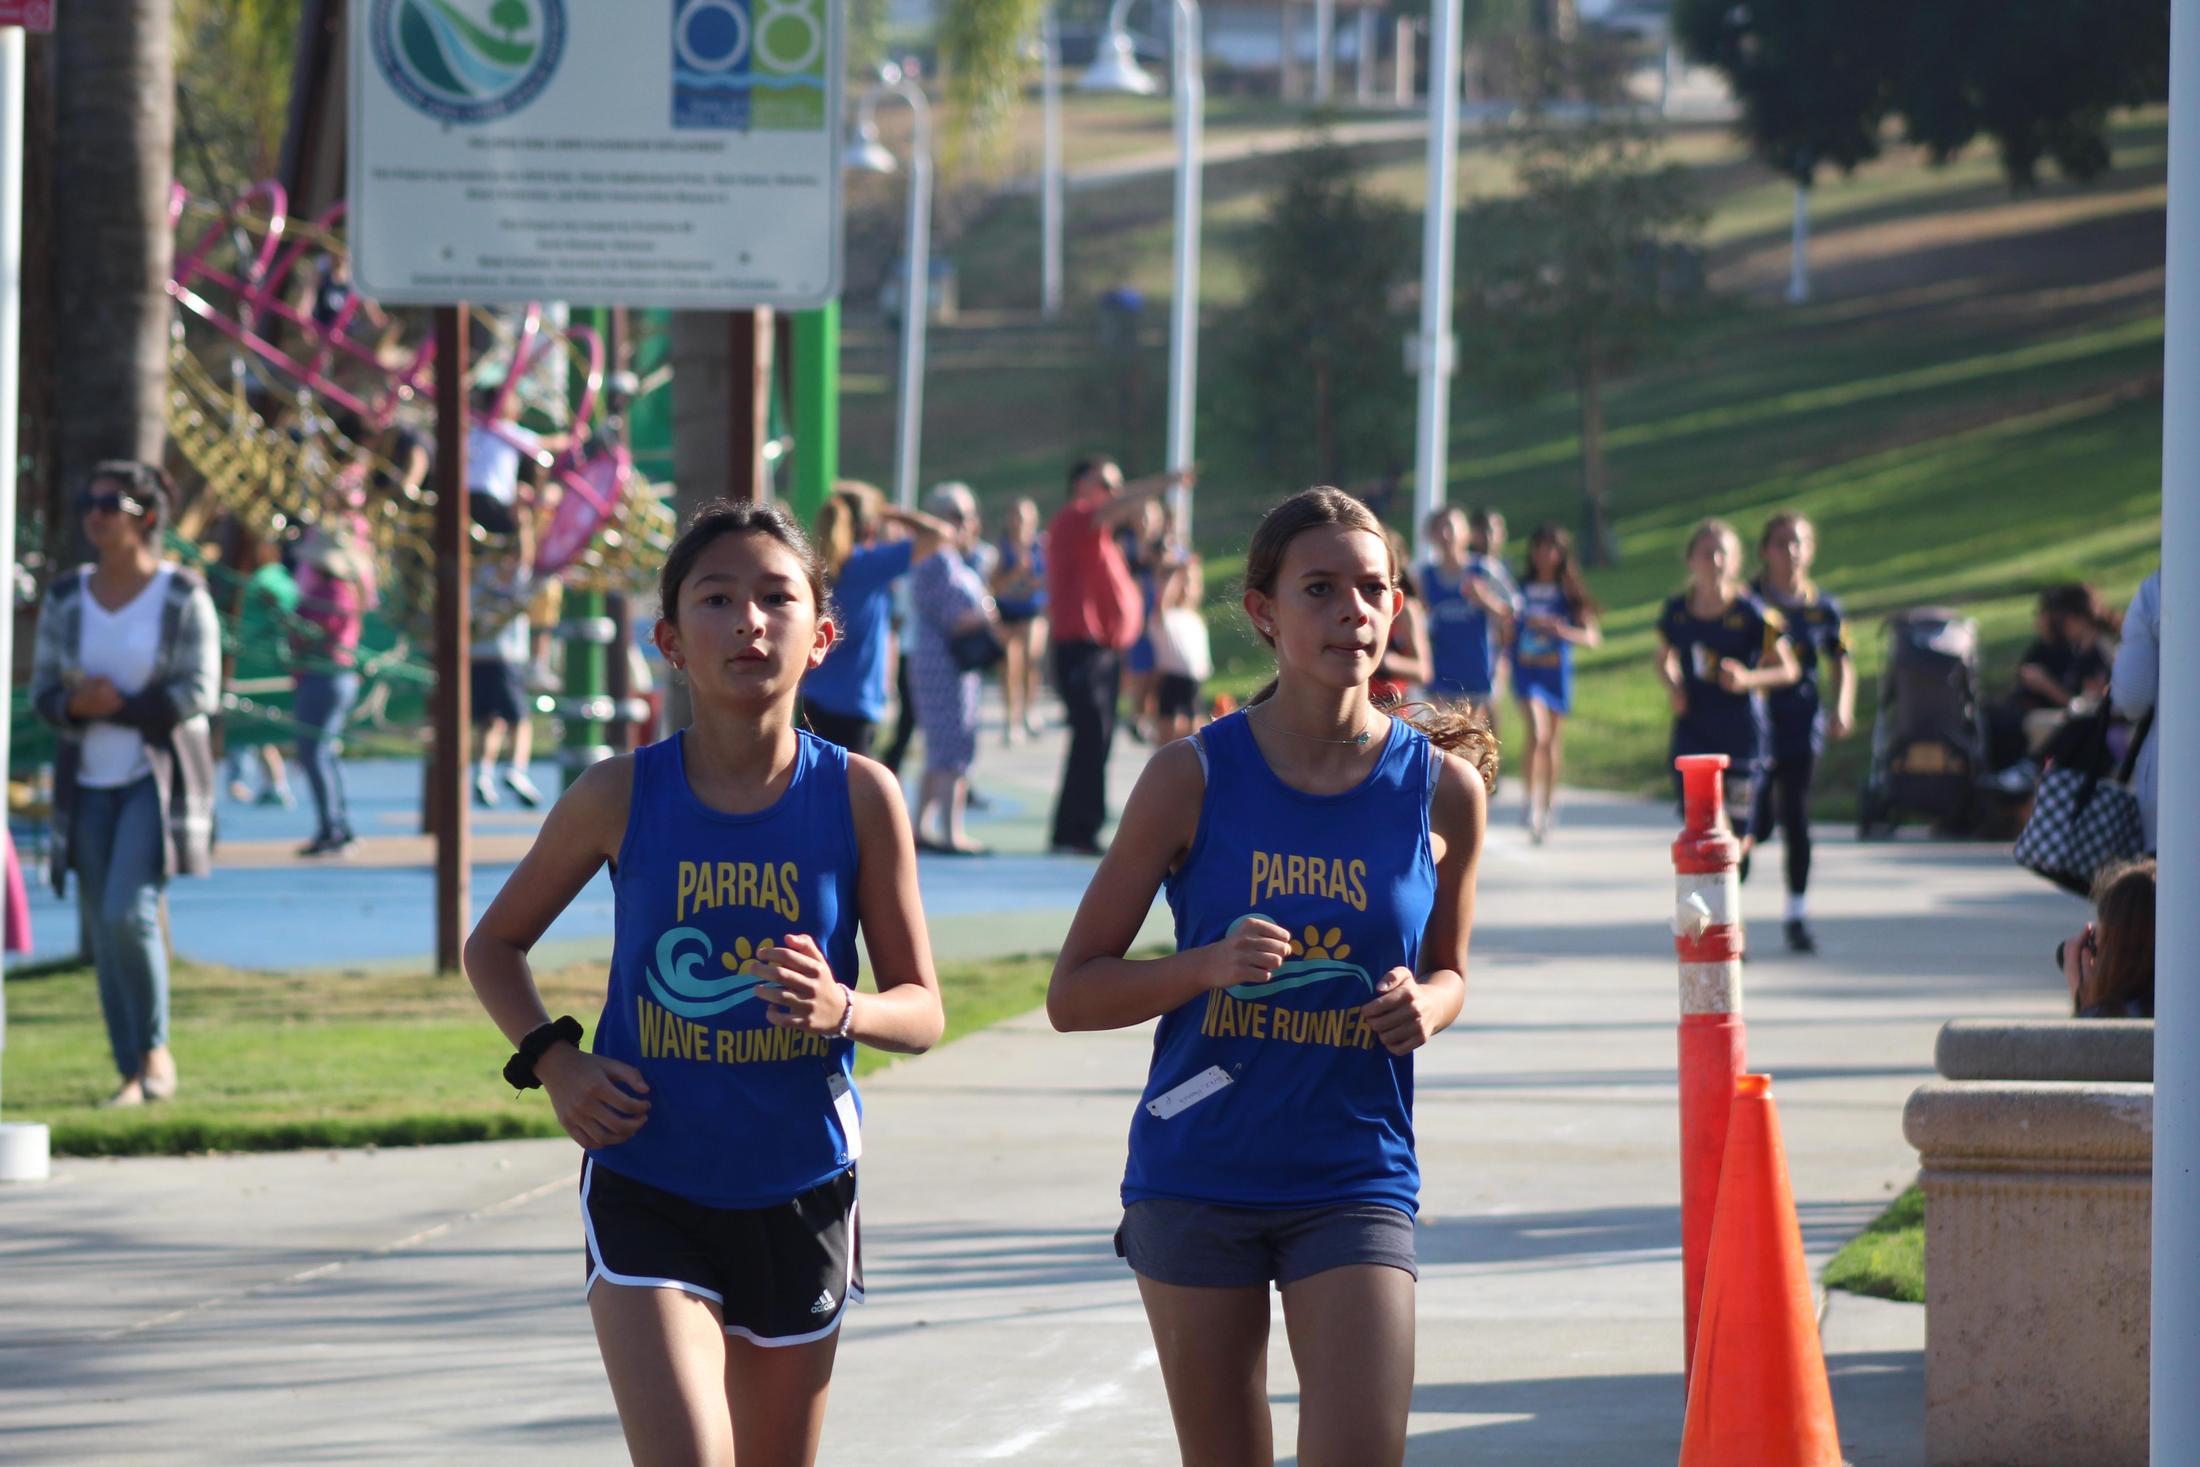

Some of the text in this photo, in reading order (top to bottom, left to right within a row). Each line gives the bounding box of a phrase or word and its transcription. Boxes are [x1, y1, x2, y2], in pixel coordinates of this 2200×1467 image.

[676, 861, 800, 922] PARRAS
[1250, 850, 1367, 912] PARRAS
[637, 995, 711, 1061] WAVE
[1200, 987, 1375, 1050] WAVE RUNNER
